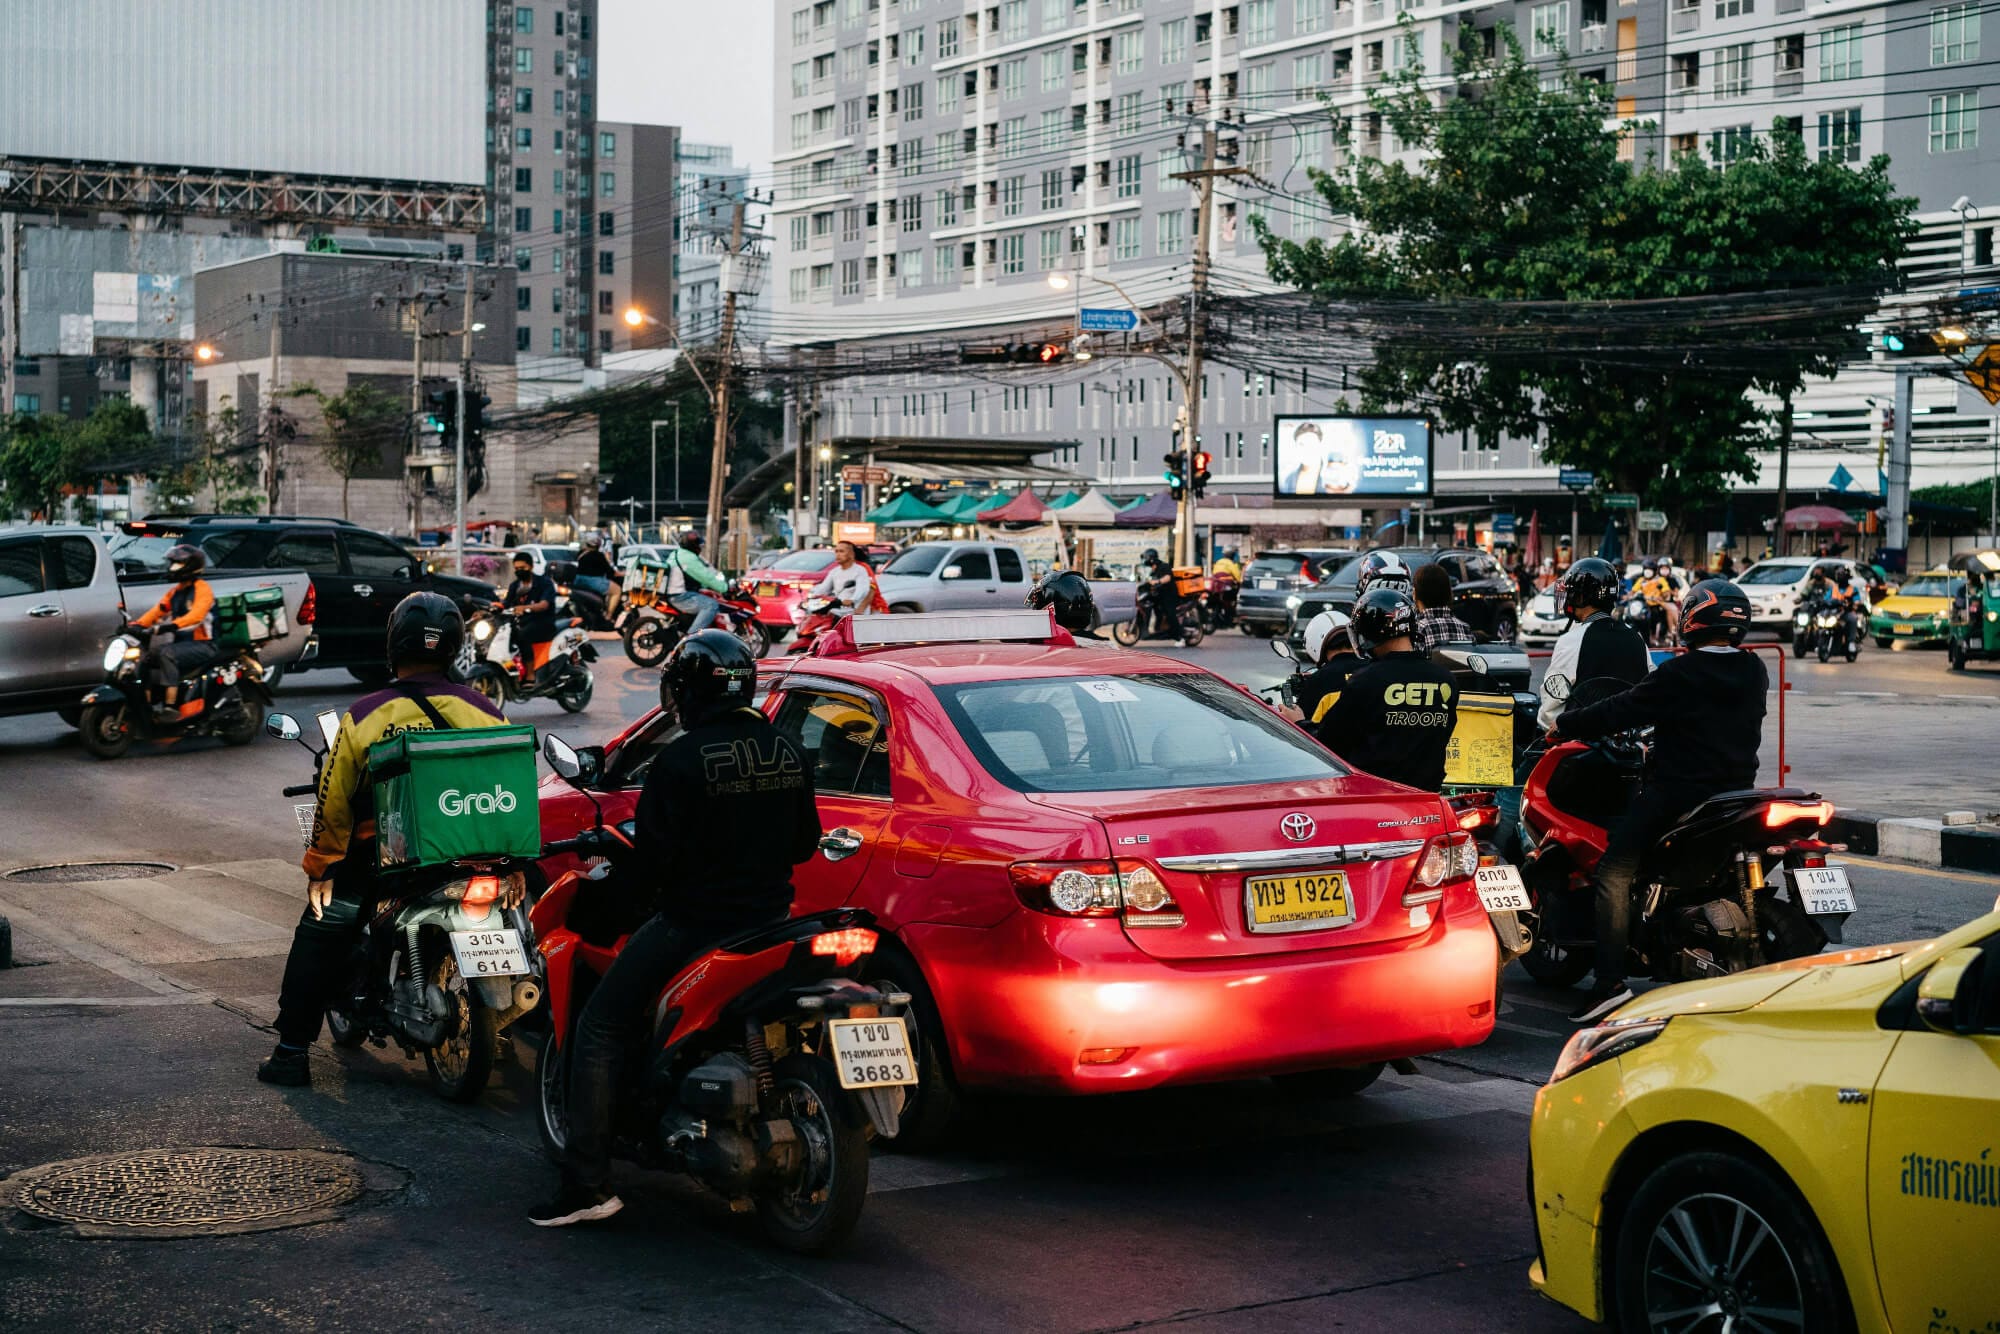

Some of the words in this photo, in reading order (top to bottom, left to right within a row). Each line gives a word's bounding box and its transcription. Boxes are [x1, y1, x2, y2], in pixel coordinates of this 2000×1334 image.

[1386, 711, 1449, 727] TROOP!
[700, 735, 802, 782] FILA
[756, 777, 780, 791] DELLO
[438, 783, 517, 817] Grab
[1408, 814, 1440, 826] ALTIS
[1295, 877, 1343, 903] 1922
[1486, 896, 1522, 909] 1335
[1811, 899, 1848, 912] 7825
[469, 933, 505, 946] 3ขจ
[477, 960, 512, 973] 614
[840, 1047, 908, 1063] กรุงเทพมหานคร
[853, 1064, 904, 1083] 3683
